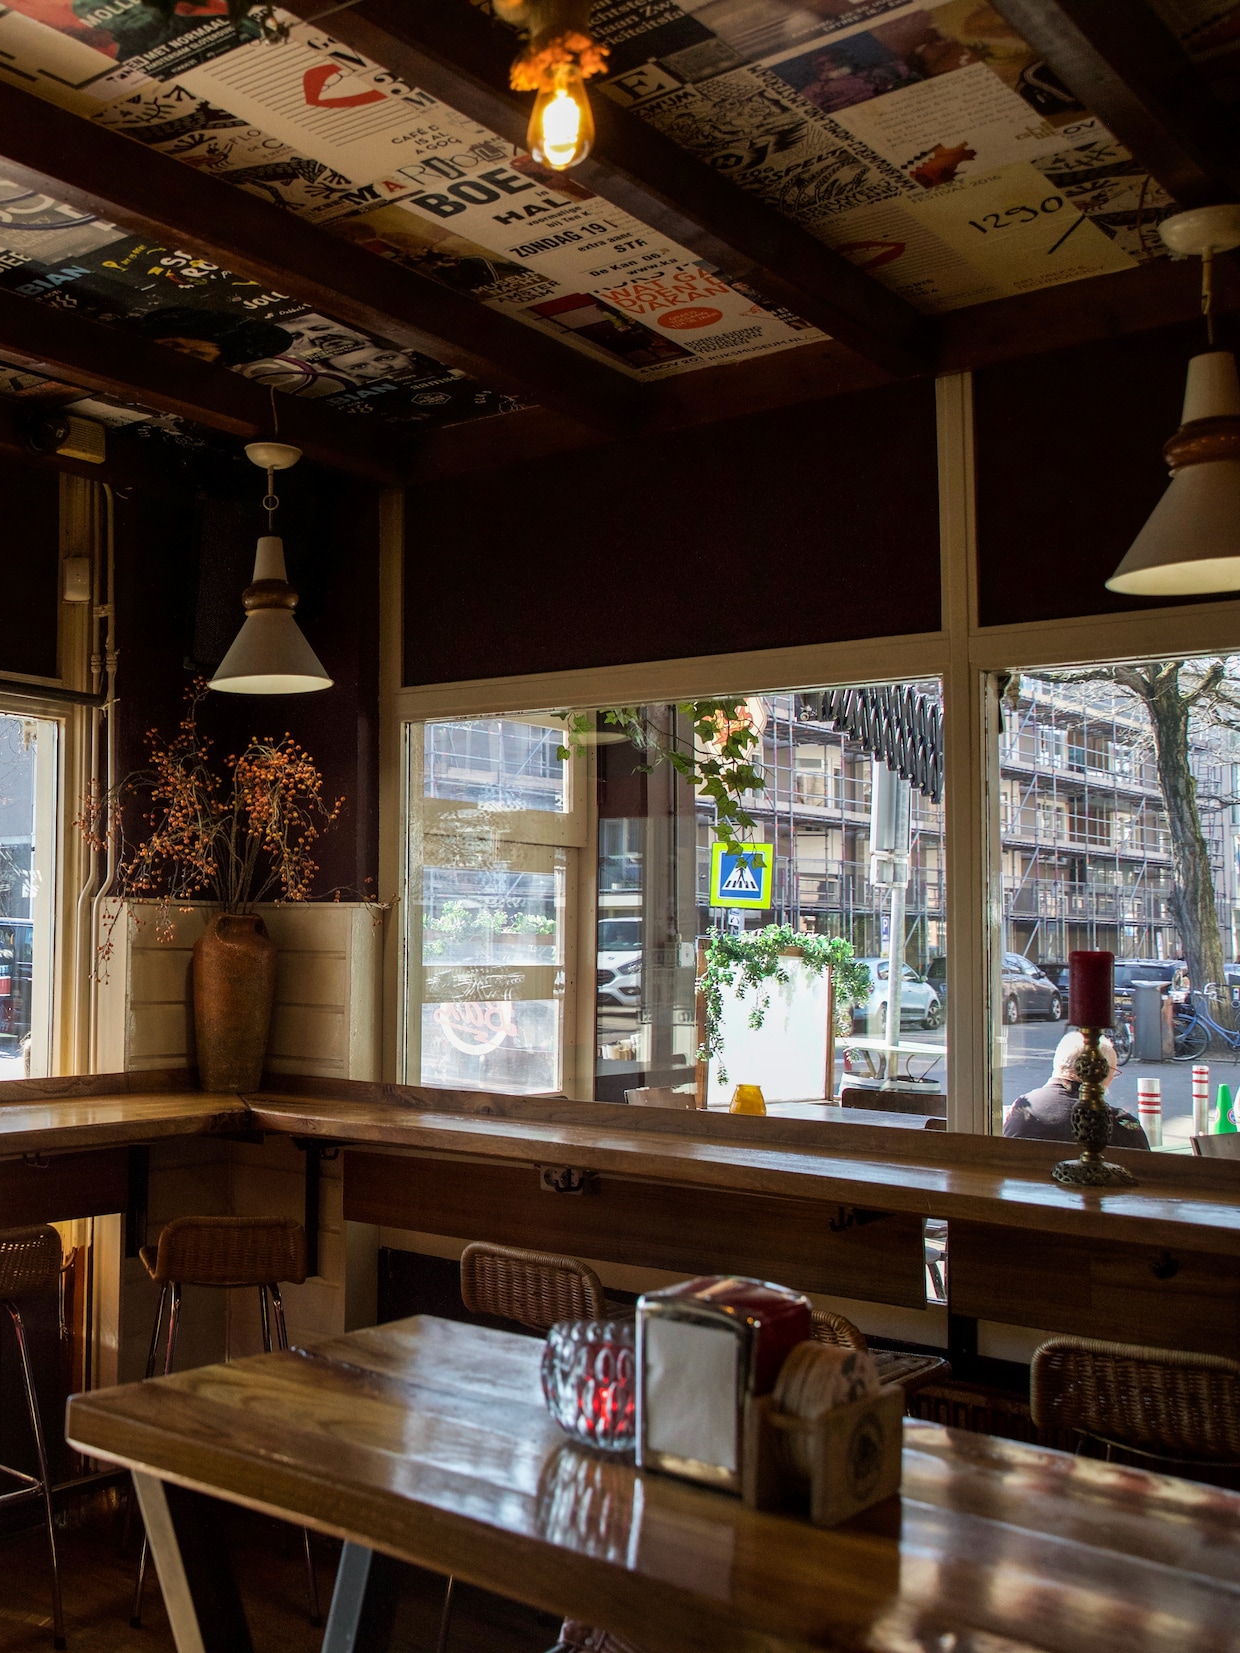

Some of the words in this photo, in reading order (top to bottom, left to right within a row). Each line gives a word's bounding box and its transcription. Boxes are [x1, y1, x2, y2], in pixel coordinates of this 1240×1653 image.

[172, 16, 231, 48] NORMAAL
[391, 127, 427, 145] CAFÉ
[414, 138, 429, 150] IS
[415, 147, 427, 155] A
[409, 167, 537, 218] BOE
[535, 190, 549, 198] in
[492, 198, 572, 225] HAL
[527, 205, 583, 226] voormalige
[546, 219, 564, 229] bij
[562, 213, 582, 224] Ten
[509, 231, 582, 258] ZONDAG
[581, 223, 608, 237] 19
[577, 239, 608, 253] extra
[589, 268, 610, 278] De
[610, 259, 638, 272] Kan
[600, 279, 664, 301] WAT
[613, 282, 693, 309] DOEN
[624, 284, 730, 315] VAKAN
